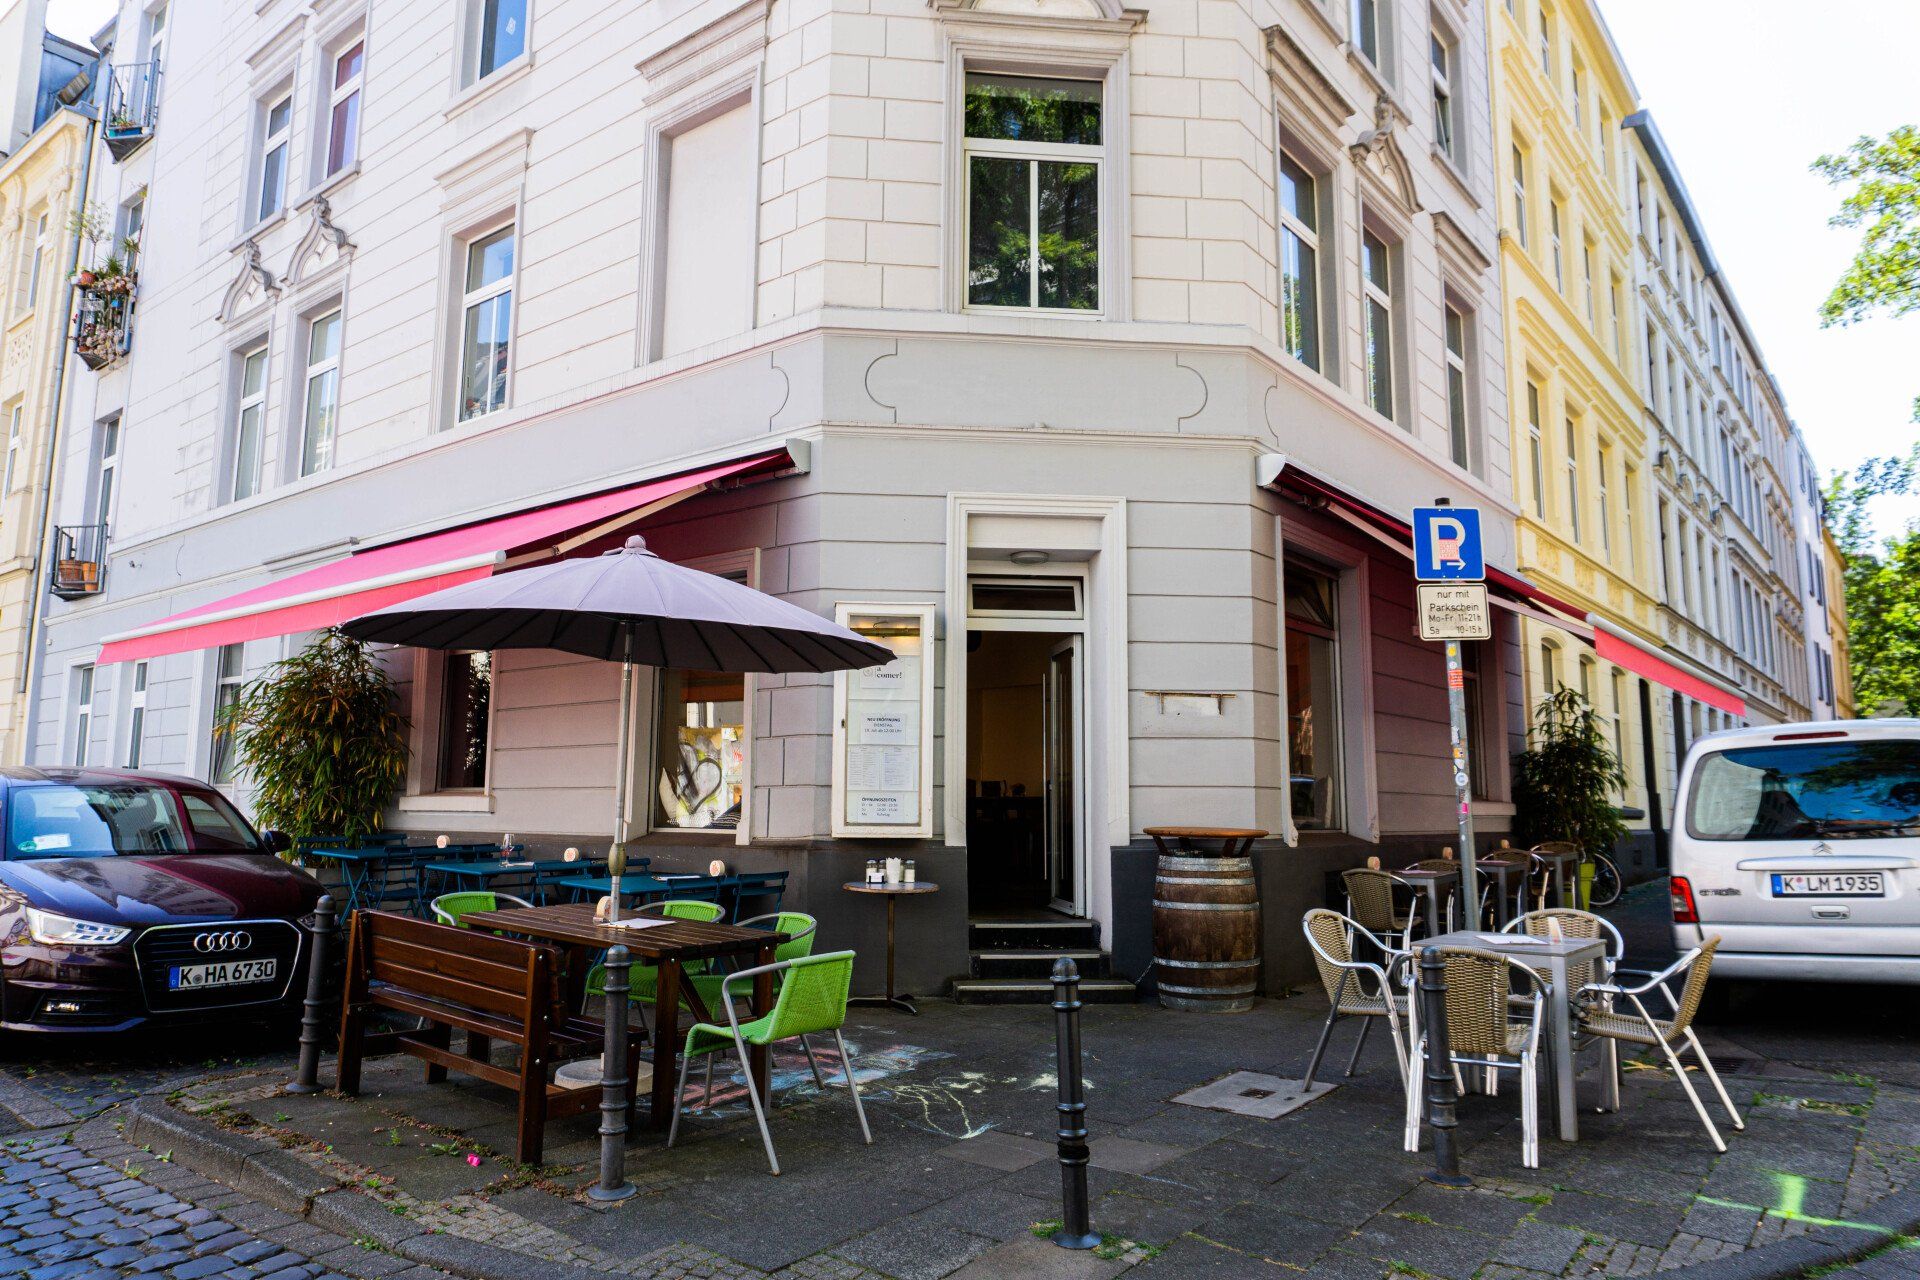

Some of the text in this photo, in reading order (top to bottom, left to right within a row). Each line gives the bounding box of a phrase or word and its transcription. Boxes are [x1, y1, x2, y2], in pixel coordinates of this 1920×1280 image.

[1430, 517, 1465, 570] P
[1437, 590, 1469, 599] nur mit
[1429, 603, 1479, 612] Parkschein
[1428, 614, 1453, 623] Mo-Fr
[1429, 626, 1440, 635] Sa
[1784, 877, 1795, 891] K
[1807, 877, 1831, 891] LM
[1835, 876, 1879, 891] 1935
[180, 968, 193, 986] K
[205, 965, 228, 983] HA
[232, 961, 274, 980] 6730
